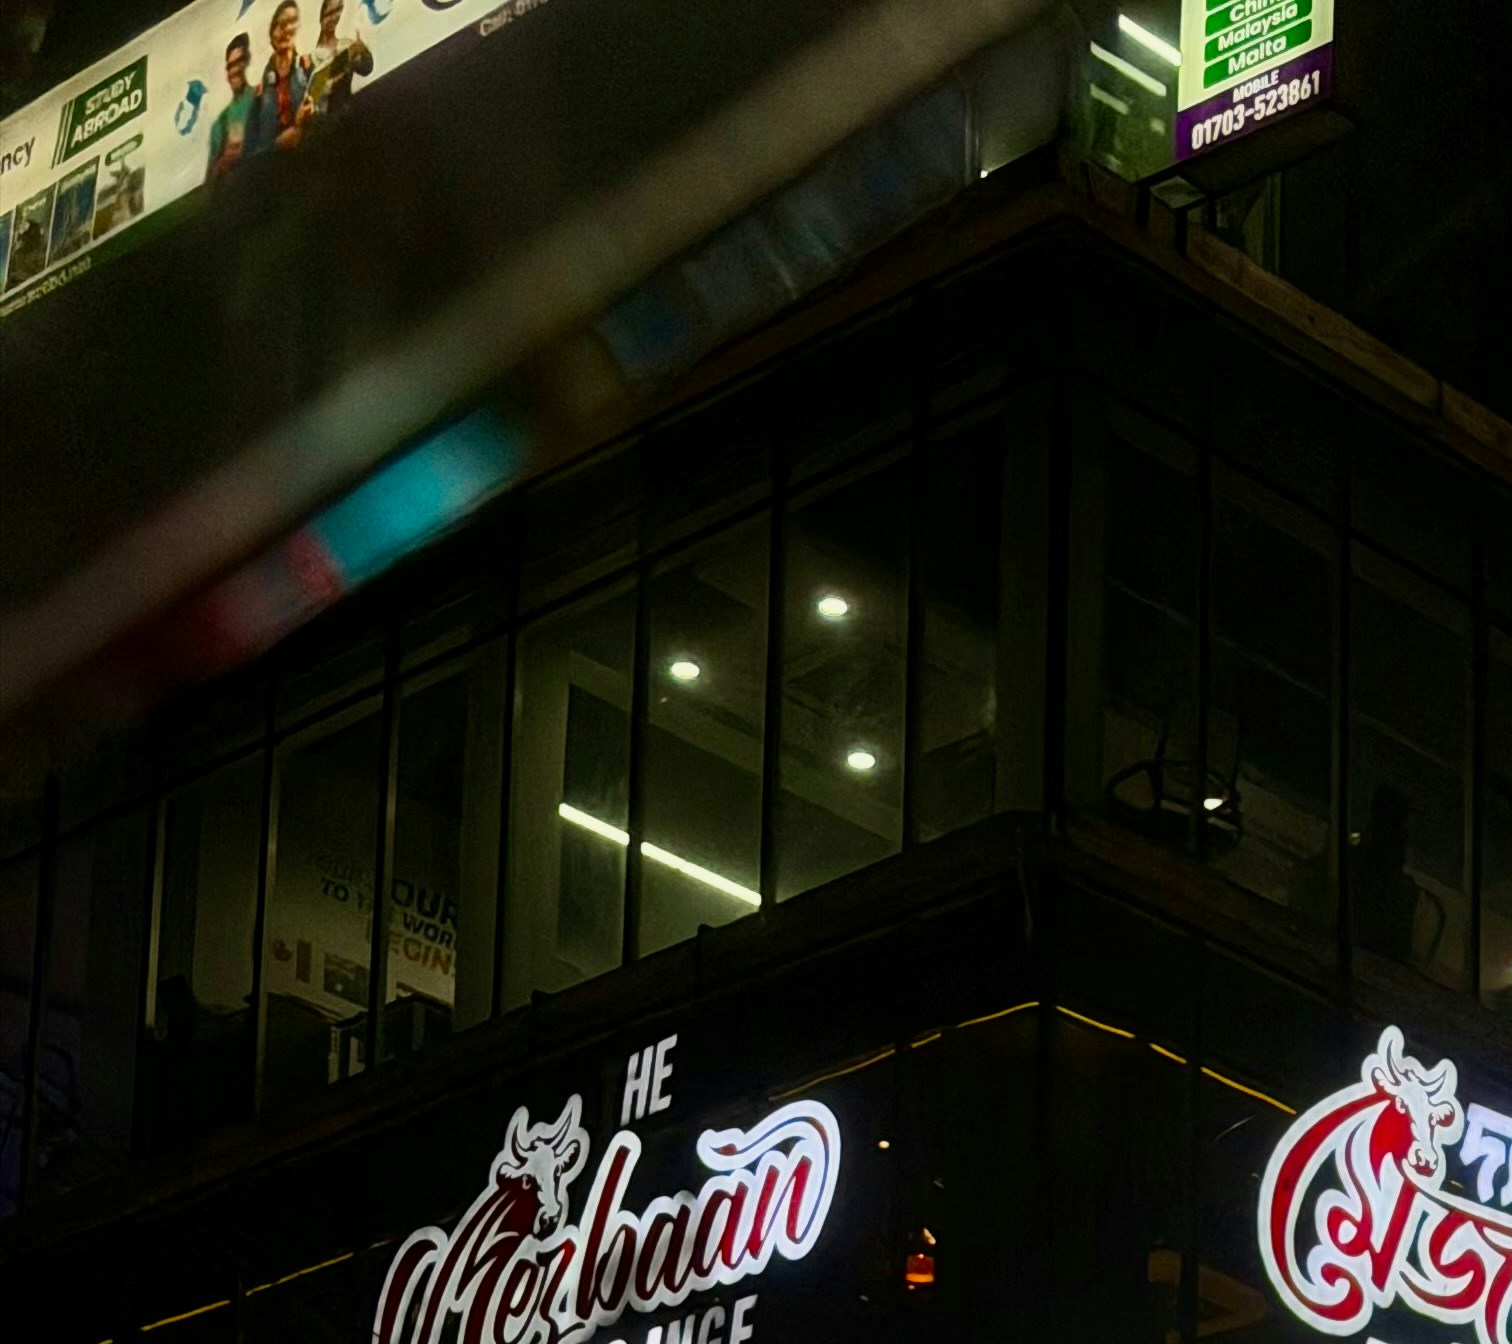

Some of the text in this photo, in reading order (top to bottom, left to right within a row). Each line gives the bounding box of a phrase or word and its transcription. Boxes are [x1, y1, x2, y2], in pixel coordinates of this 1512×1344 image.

[1218, 3, 1298, 51] Malaysia
[1228, 36, 1287, 75] Malta
[85, 70, 137, 116] STUDY
[1191, 69, 1321, 150] 01703-523861
[1232, 69, 1280, 103] MOBILE
[71, 88, 143, 150] ABROAD
[620, 1034, 678, 1127] HE
